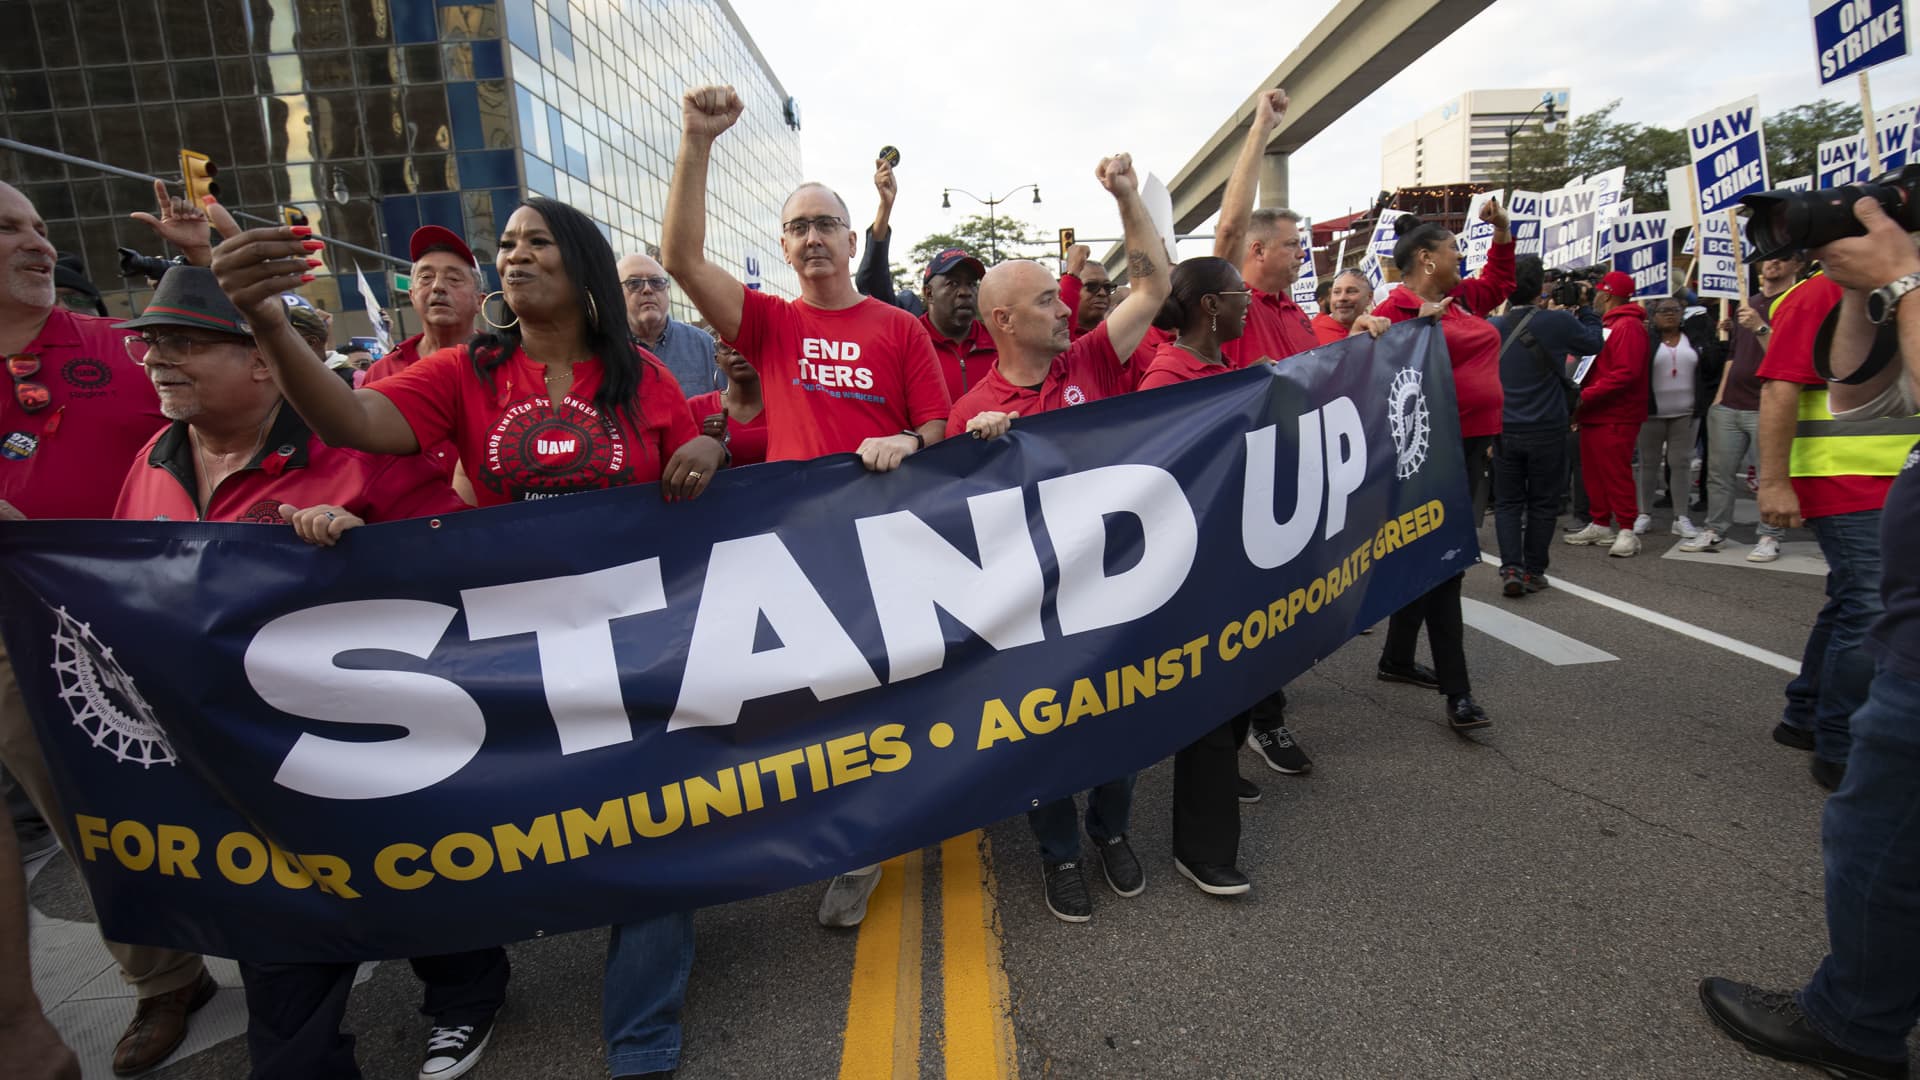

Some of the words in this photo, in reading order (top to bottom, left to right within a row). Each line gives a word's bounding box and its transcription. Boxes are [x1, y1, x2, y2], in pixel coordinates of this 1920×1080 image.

[1839, 0, 1872, 33] ON
[1821, 4, 1902, 79] STRIKE
[1692, 106, 1753, 150] UAW
[1714, 145, 1740, 178] ON
[1701, 158, 1762, 211] STRIKE
[1512, 197, 1542, 216] UA
[1545, 191, 1595, 218] UAW
[1518, 222, 1536, 239] ON
[1559, 219, 1578, 245] ON
[1614, 218, 1667, 243] UAW
[1475, 240, 1487, 250] ON
[1543, 236, 1592, 270] STRIKE
[1632, 246, 1653, 271] ON
[1717, 259, 1736, 272] ON
[1703, 275, 1739, 291] STRIK
[803, 337, 862, 361] END
[798, 358, 875, 390] TIERS
[488, 434, 502, 471] LABOR
[496, 402, 532, 432] UNITED
[535, 395, 599, 418] STONGER
[609, 443, 624, 471] EVER
[537, 439, 576, 455] UAW
[244, 463, 1199, 800] STAND
[1241, 396, 1368, 570] UP
[76, 814, 200, 879] FOR
[216, 832, 362, 899] OUR
[374, 723, 912, 890] COMMUNITIES
[976, 635, 1210, 751] AGAINST
[1218, 543, 1371, 662] CORPORATE
[1373, 499, 1445, 560] GREED
